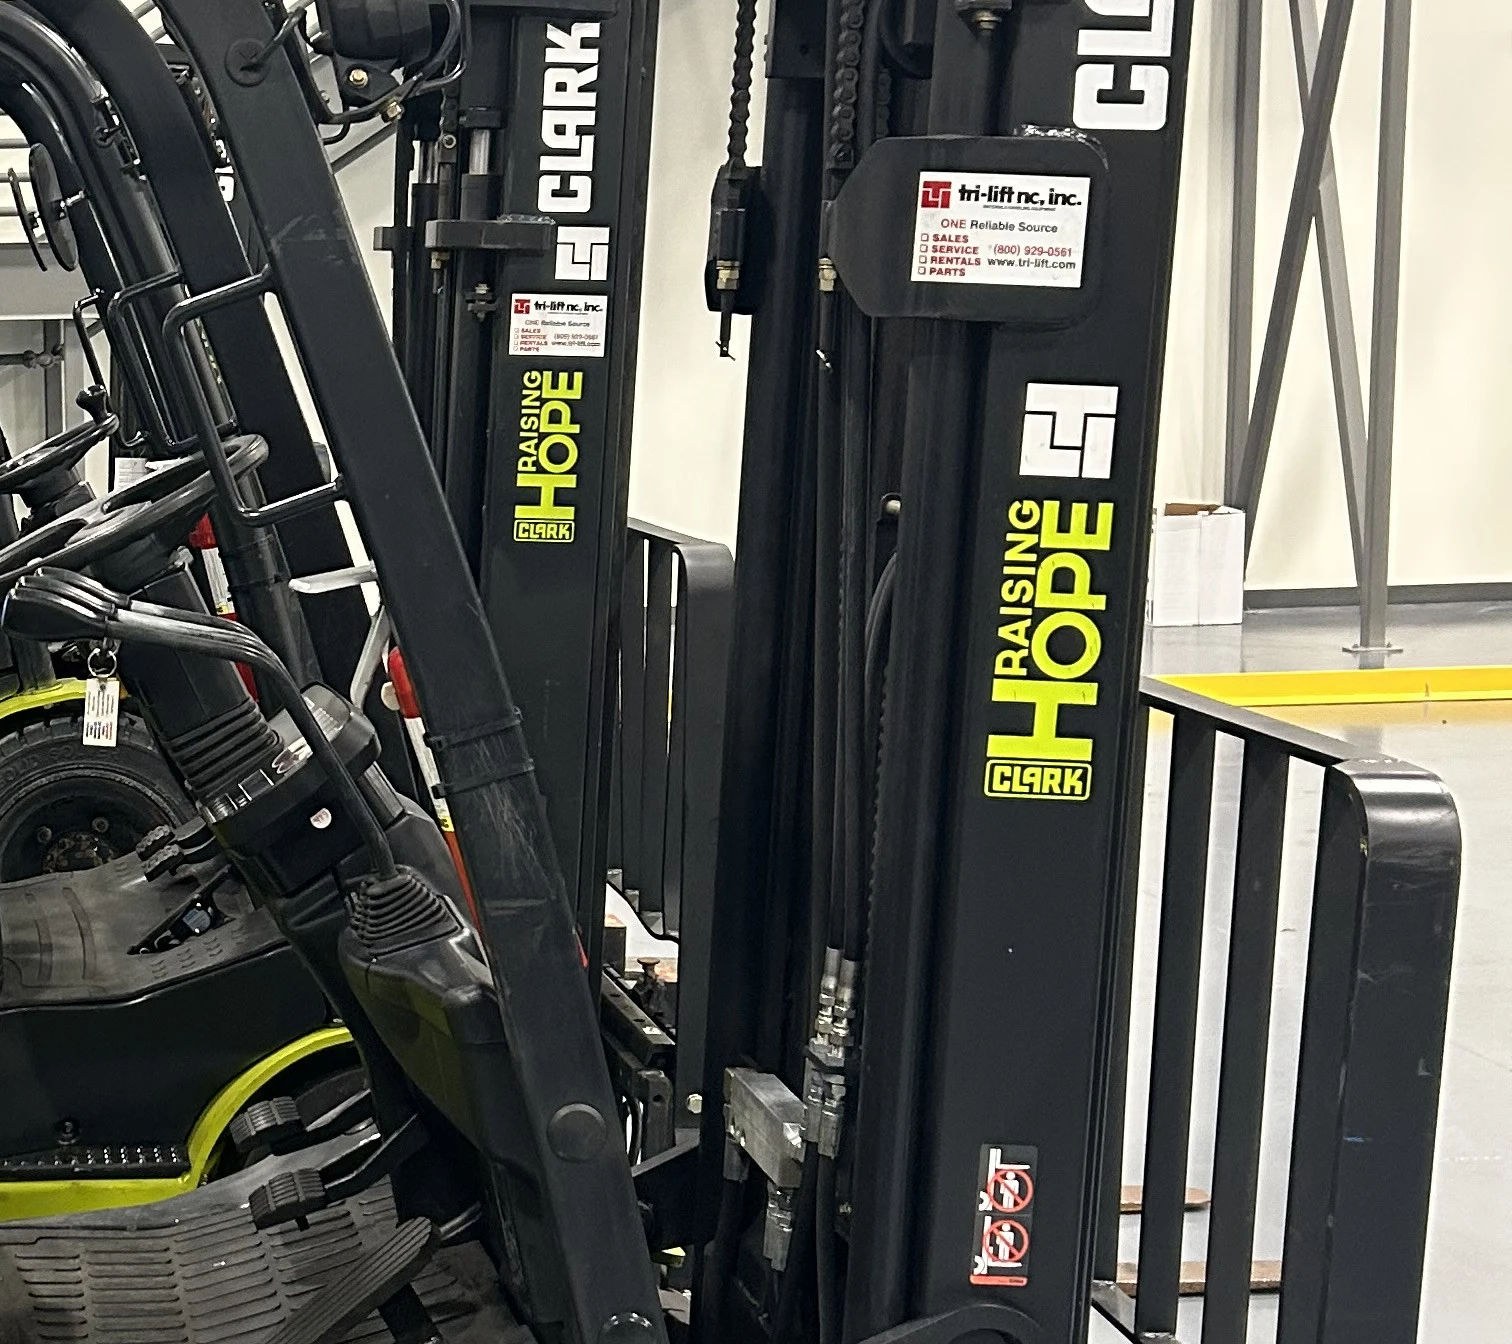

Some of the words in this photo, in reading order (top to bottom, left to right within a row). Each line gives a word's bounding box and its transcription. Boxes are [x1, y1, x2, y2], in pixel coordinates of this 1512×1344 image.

[538, 22, 601, 213] CLARK
[958, 183, 1015, 203] tri-lift
[1017, 191, 1045, 206] nc,
[1048, 188, 1082, 206] inc.
[940, 218, 966, 229] ONE
[970, 219, 1015, 232] Reliable
[1018, 222, 1058, 233] Source
[932, 233, 969, 243] SALES
[931, 245, 979, 255] SERVICE
[993, 244, 1020, 256] (800)
[1024, 246, 1072, 257] 929-0561
[930, 256, 981, 266] RENTALS
[987, 257, 1076, 269] www.tri-lift.com
[929, 267, 966, 277] PARTS
[534, 300, 565, 311] tri-lift
[517, 370, 542, 472] RAISING
[514, 370, 583, 520] HOPE
[518, 521, 571, 540] CLARK
[993, 499, 1041, 677] RAISING
[986, 499, 1114, 762] HOPE
[991, 764, 1085, 796] CLARK
